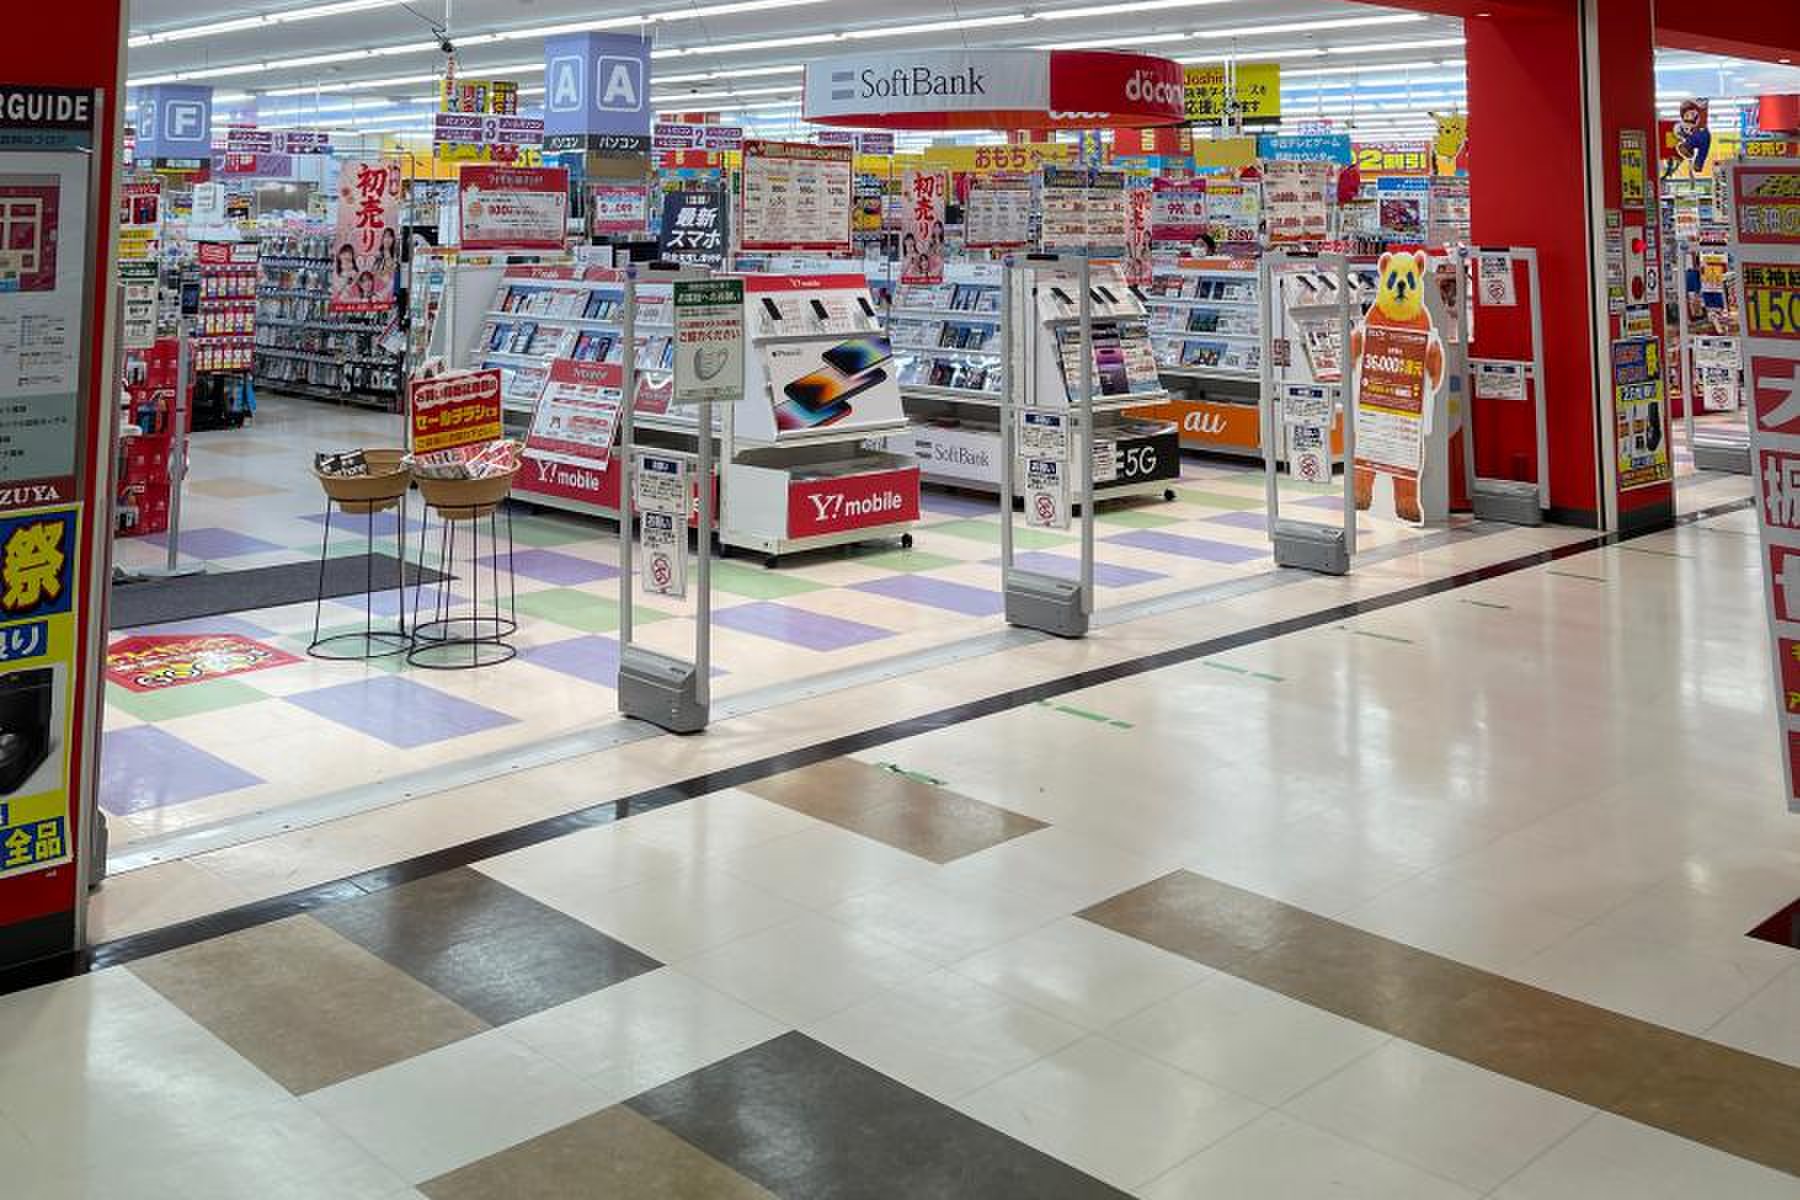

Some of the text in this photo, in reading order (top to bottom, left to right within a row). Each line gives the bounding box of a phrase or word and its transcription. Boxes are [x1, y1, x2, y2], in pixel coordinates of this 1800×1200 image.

[555, 63, 577, 103] A
[603, 64, 636, 103] A
[861, 67, 986, 98] SoftBank
[175, 107, 197, 135] F
[600, 137, 640, 150] パソコン
[356, 163, 387, 253] 初売り
[675, 207, 719, 228] 最新
[914, 171, 934, 240] 初売り
[666, 229, 721, 249] スマホ
[1183, 411, 1227, 434] au
[934, 443, 990, 468] SoftBank
[1124, 446, 1157, 478] 5G
[537, 459, 600, 491] Y!mobile
[807, 491, 903, 522] Y!mobile
[3, 520, 66, 610] 祭
[5, 819, 62, 869] 全品
